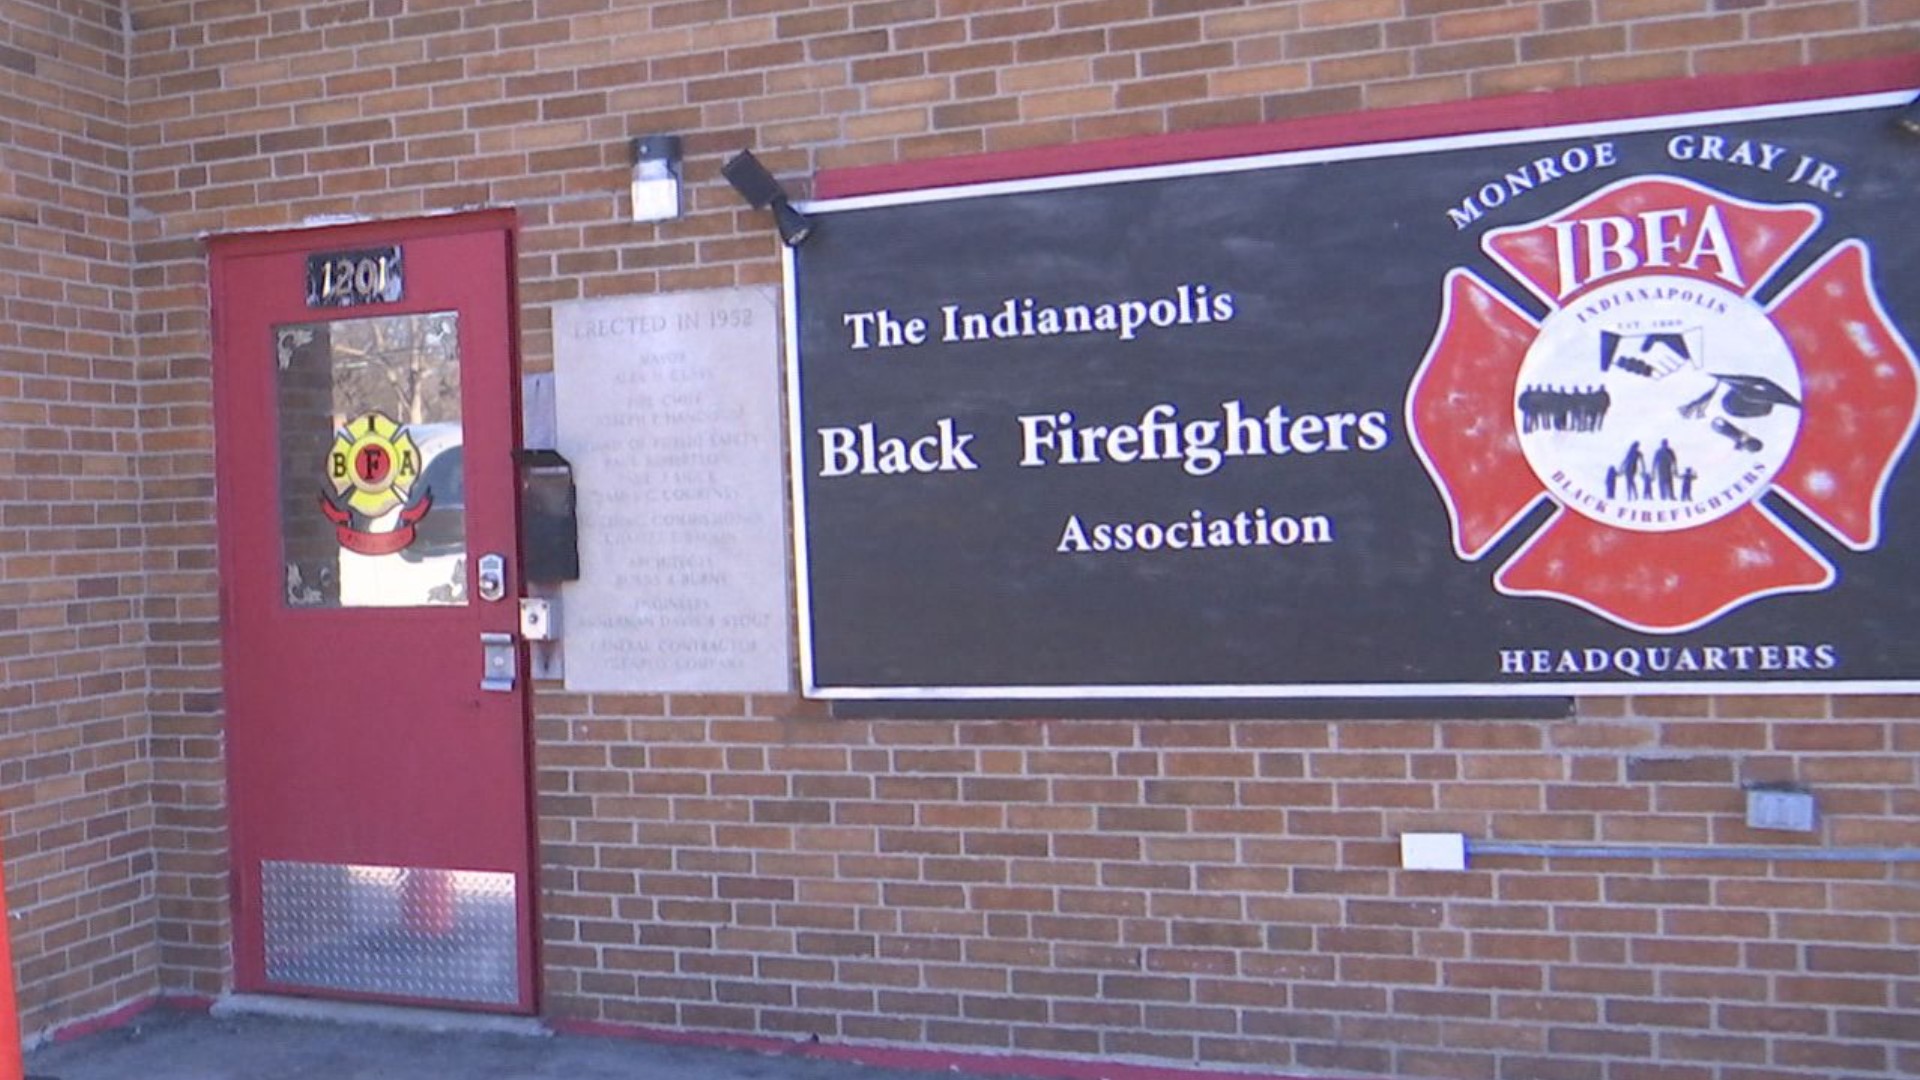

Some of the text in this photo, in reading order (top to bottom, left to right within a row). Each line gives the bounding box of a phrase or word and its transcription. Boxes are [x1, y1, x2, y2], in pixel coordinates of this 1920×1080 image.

[1446, 134, 1845, 231] MONROE GRAY JR.
[1549, 204, 1746, 301] IBFA
[322, 256, 387, 298] 1201
[574, 308, 754, 339] ERECTED IN 1952
[843, 285, 1234, 350] The Indianapolis
[1576, 286, 1728, 324] INDIANAPOLIS
[818, 400, 1389, 477] Black Firefighters
[333, 449, 416, 480] B F A
[1550, 461, 1768, 523] BLACK FIREFIGHTERS
[1057, 508, 1334, 552] Association
[1499, 644, 1838, 677] HEADQUARTERS
